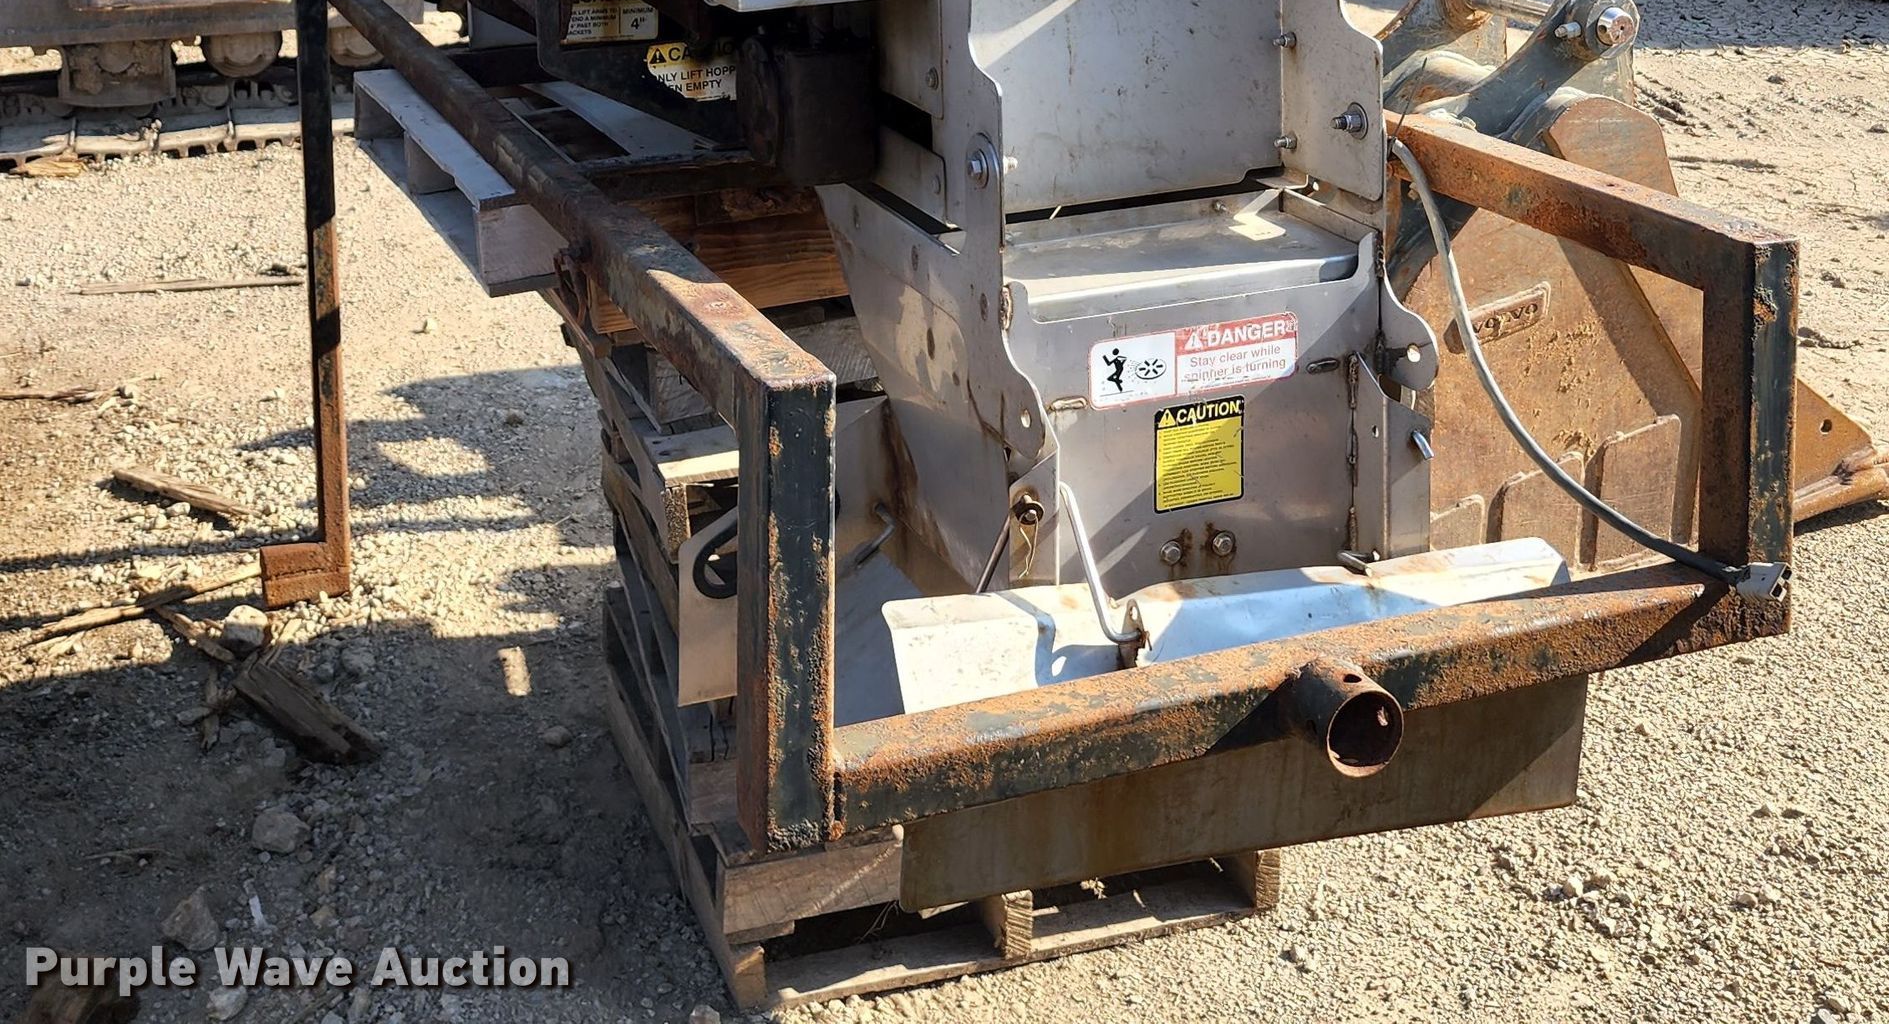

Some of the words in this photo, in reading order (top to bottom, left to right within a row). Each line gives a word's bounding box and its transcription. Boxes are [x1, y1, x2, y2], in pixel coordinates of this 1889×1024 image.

[630, 17, 645, 30] 4"
[680, 69, 704, 80] LIFT
[685, 79, 722, 92] EMPTY
[1206, 319, 1286, 347] DANGER
[1190, 356, 1216, 369] Stay
[1219, 350, 1249, 364] clear
[1250, 345, 1281, 358] while
[1231, 364, 1242, 376] is
[1244, 357, 1287, 373] turning
[1176, 400, 1240, 423] CAUTION
